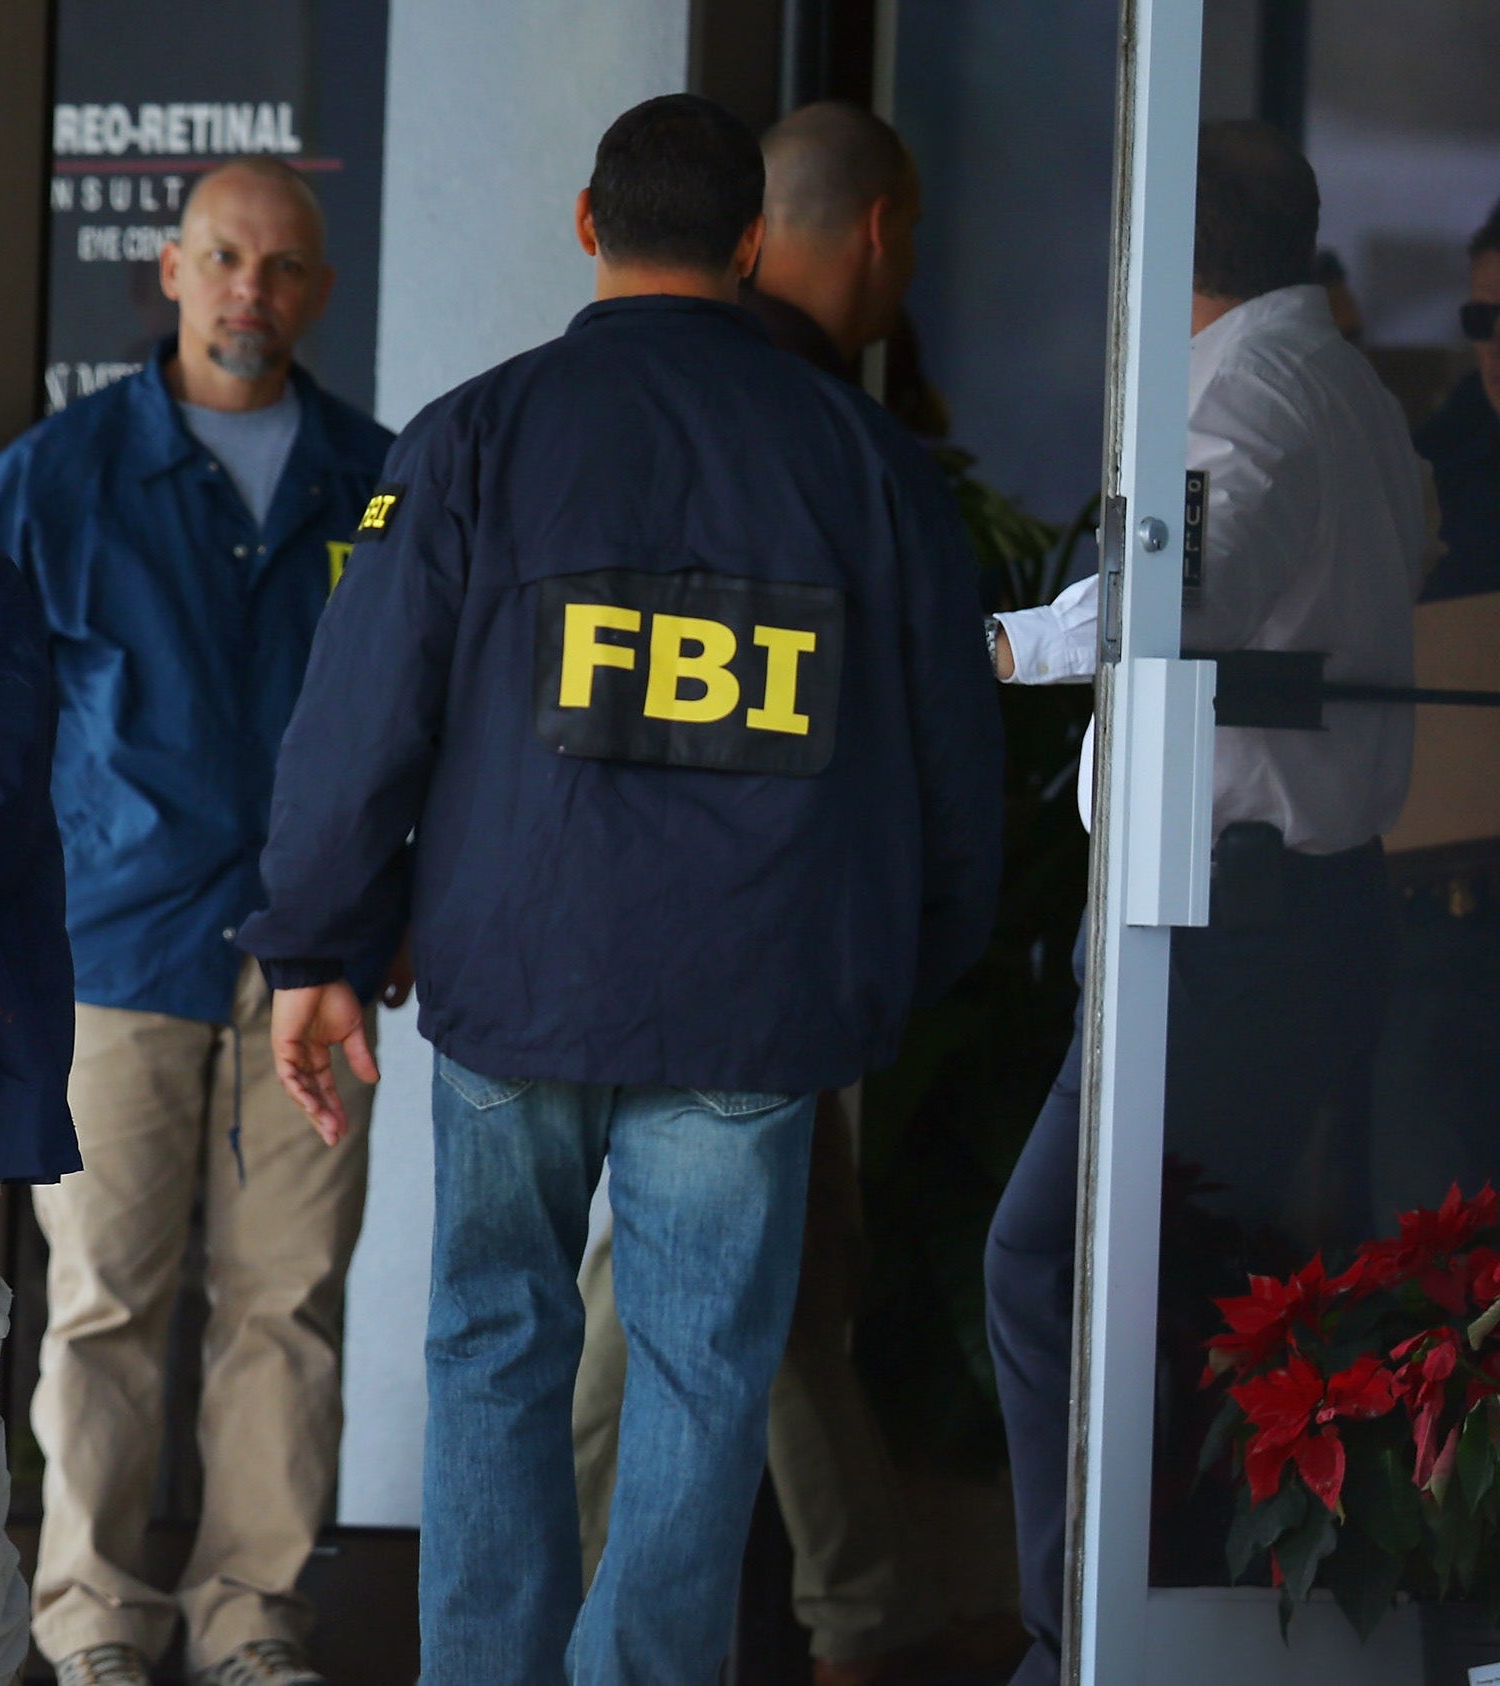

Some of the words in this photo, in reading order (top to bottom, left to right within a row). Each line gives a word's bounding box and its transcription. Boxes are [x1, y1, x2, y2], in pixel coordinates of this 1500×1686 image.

[78, 225, 121, 262] EYE
[358, 494, 396, 531] BI
[558, 602, 816, 735] FBI
